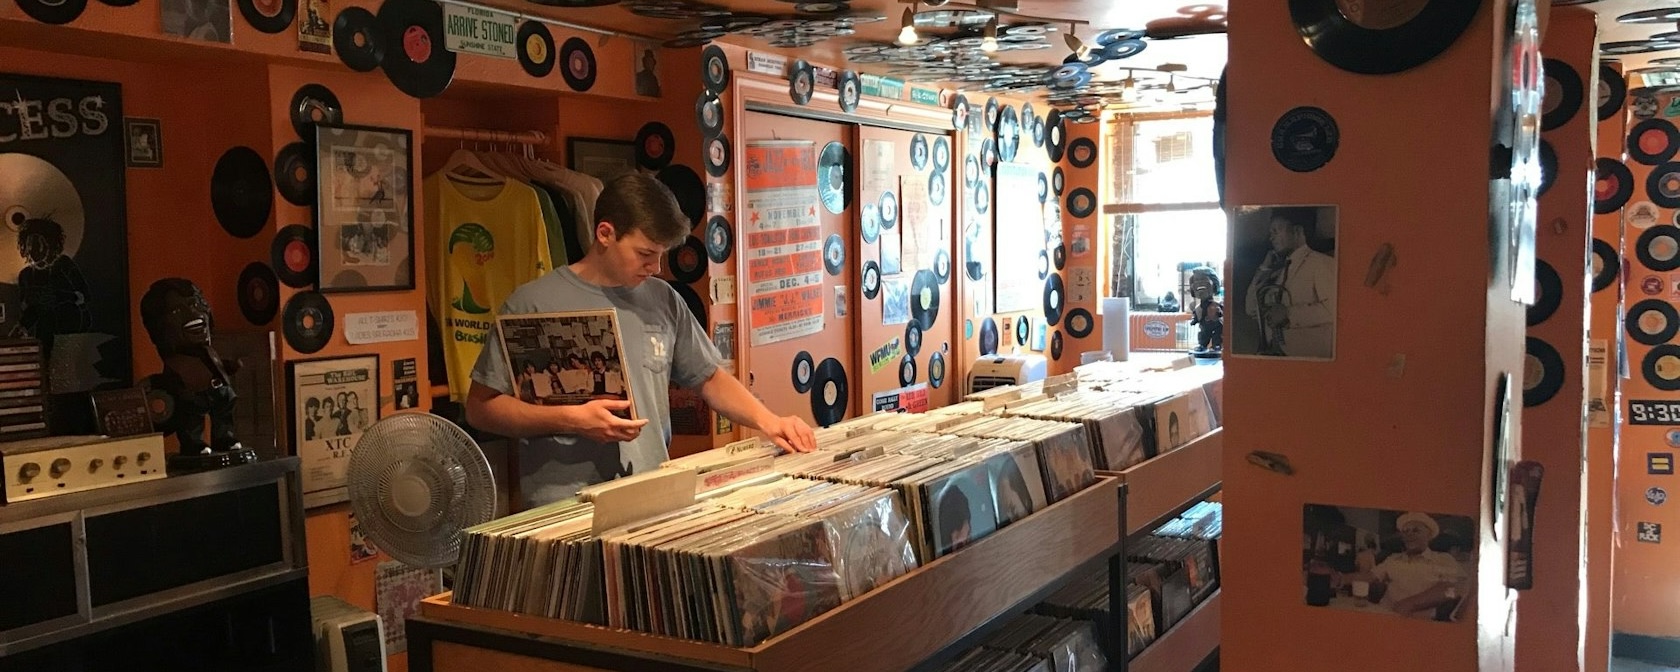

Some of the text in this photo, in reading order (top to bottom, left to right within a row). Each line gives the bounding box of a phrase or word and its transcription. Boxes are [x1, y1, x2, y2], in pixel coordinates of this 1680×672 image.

[467, 8, 494, 17] FLORIDA
[447, 14, 514, 44] ARRIVE STONED
[460, 40, 503, 52] SUNSHINE STATE
[779, 278, 800, 290] DEC.
[455, 319, 490, 331] WORLD
[1632, 403, 1680, 422] 9:30
[325, 436, 352, 451] XTC
